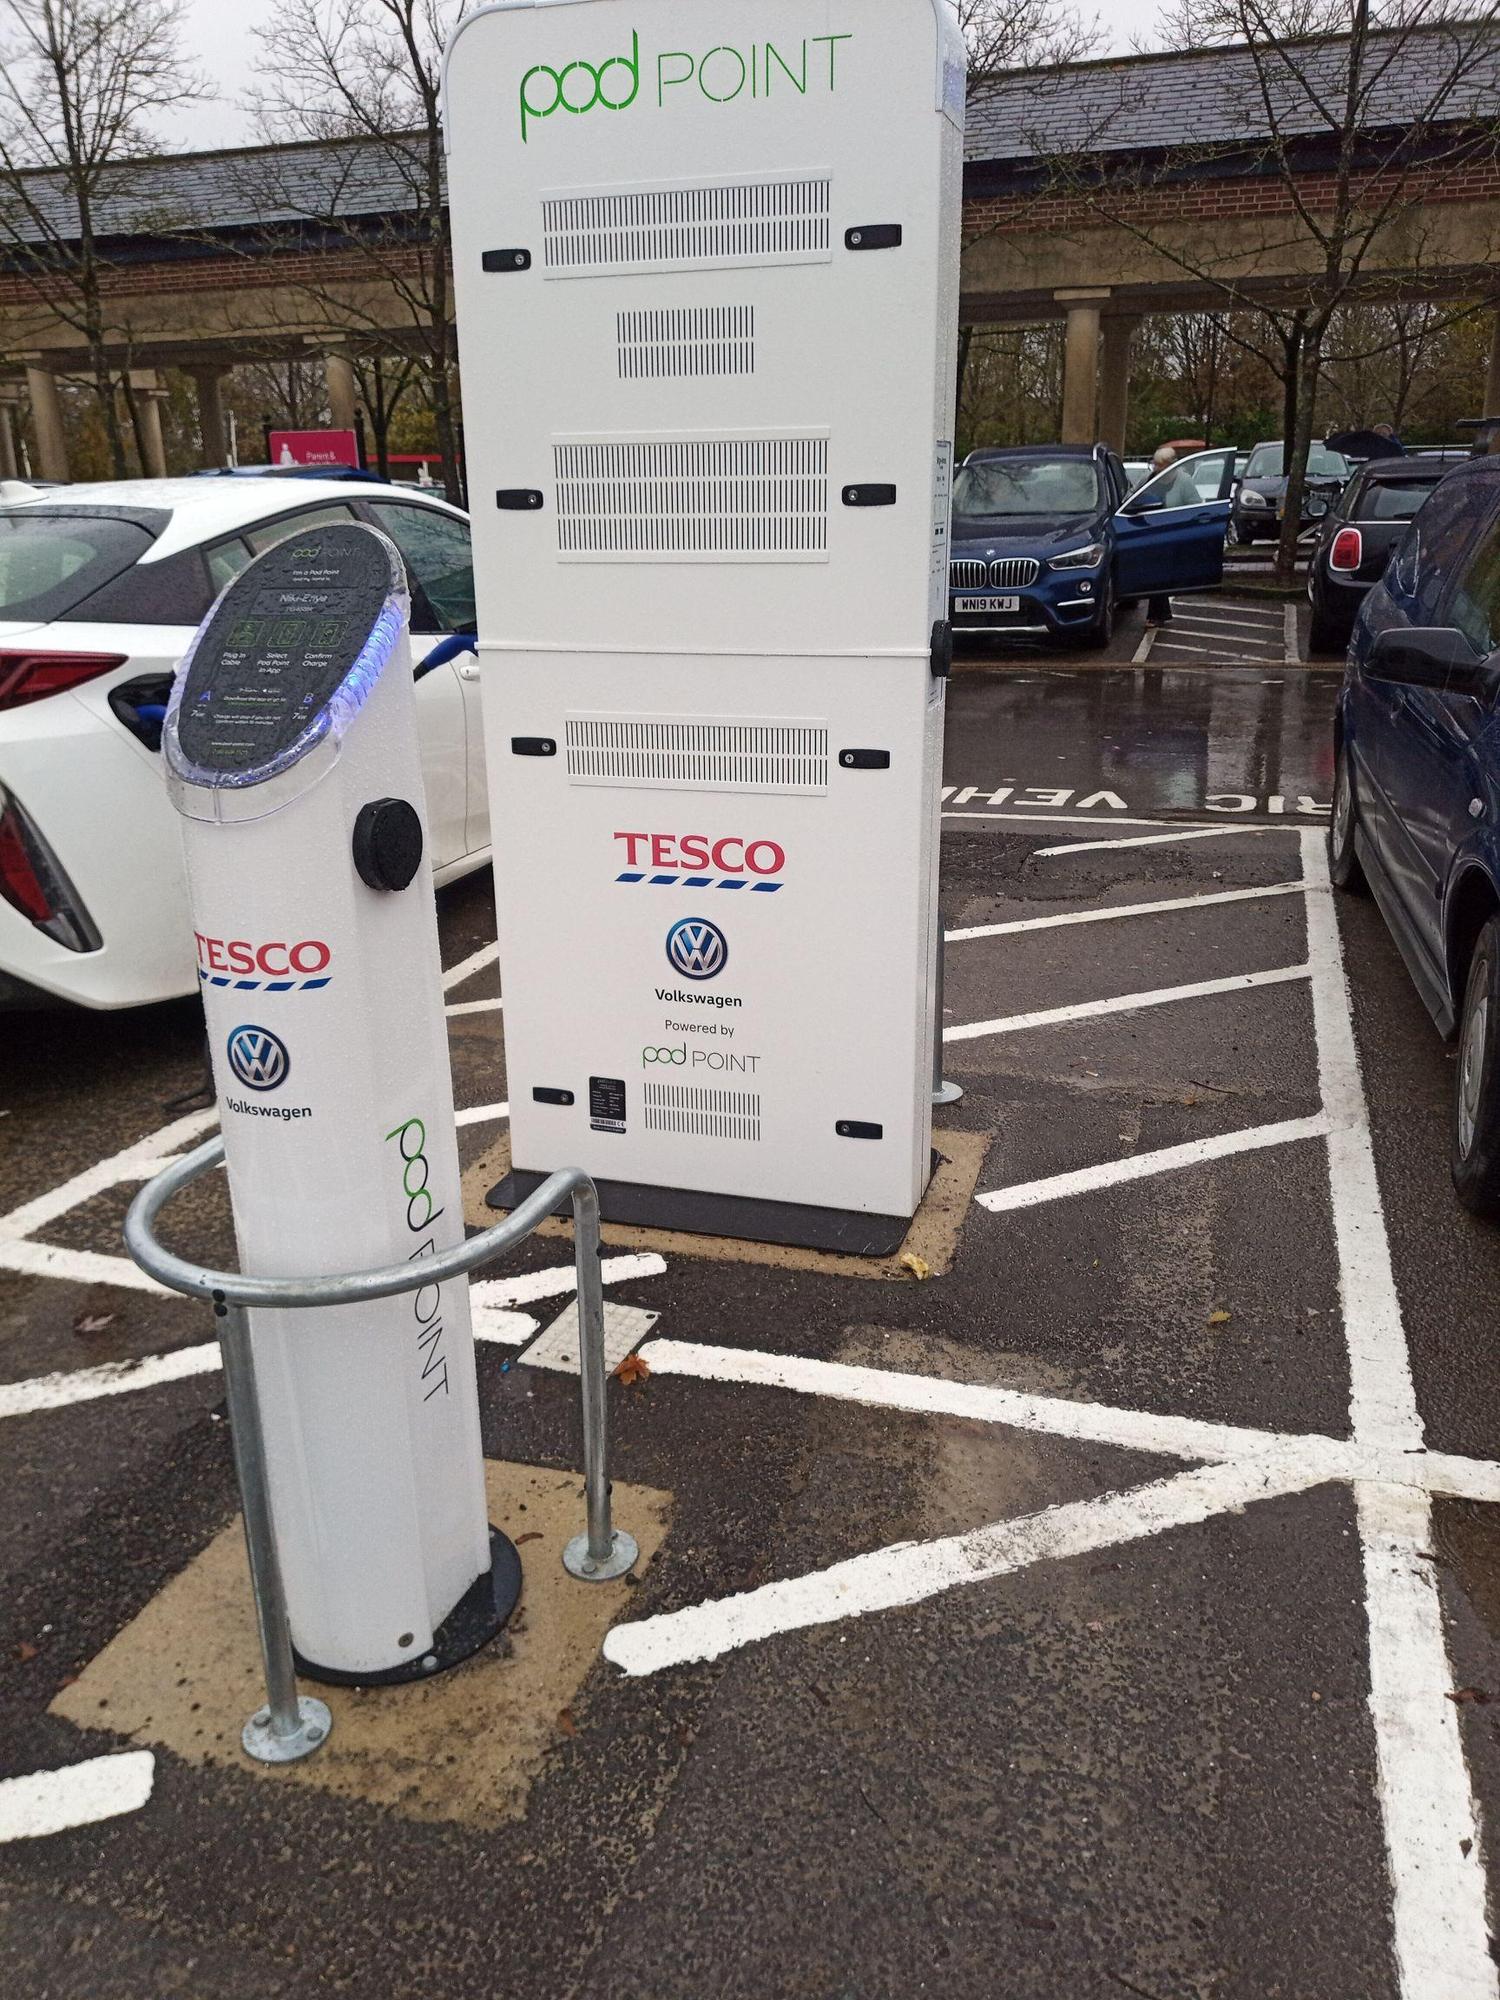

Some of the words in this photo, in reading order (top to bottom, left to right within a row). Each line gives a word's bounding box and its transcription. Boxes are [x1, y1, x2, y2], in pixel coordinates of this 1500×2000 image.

[519, 28, 640, 145] pod
[657, 33, 853, 107] POINT
[962, 599, 987, 610] WN19
[989, 598, 1012, 610] KWJ
[223, 652, 239, 660] Plug
[302, 660, 328, 668] Charge
[304, 652, 333, 660] Confirm
[200, 690, 211, 701] A
[303, 692, 314, 704] B
[614, 832, 785, 875] TESCO
[194, 930, 331, 976] TESCO
[654, 988, 743, 1009] Volkswagen
[664, 1019, 718, 1035] Powered
[720, 1024, 735, 1038] by
[642, 1041, 687, 1070] pod
[692, 1050, 761, 1073] POINT
[226, 1096, 312, 1121] Volkswagen
[385, 1117, 446, 1232] pod
